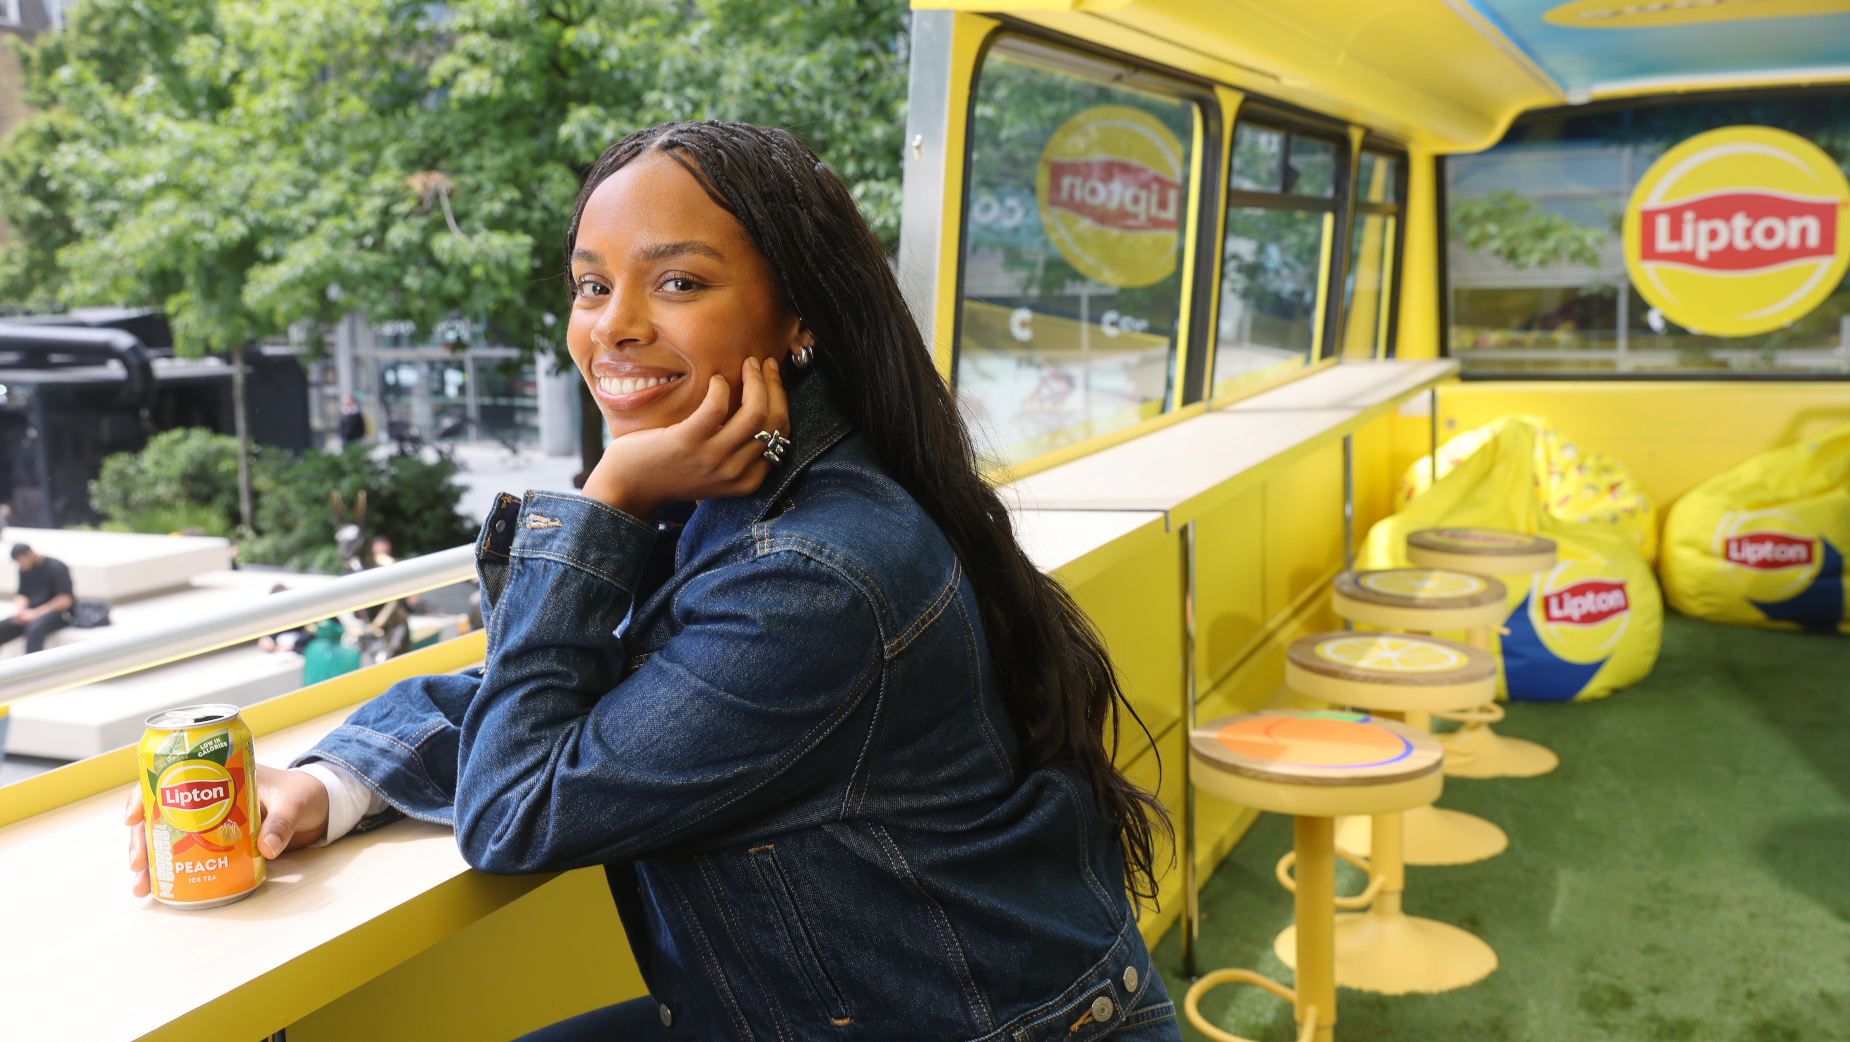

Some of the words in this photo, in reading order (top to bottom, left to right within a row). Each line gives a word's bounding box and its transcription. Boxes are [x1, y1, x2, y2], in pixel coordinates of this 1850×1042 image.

[1654, 210, 1821, 262] Lipton
[1728, 538, 1808, 565] Lipton
[1550, 588, 1626, 621] Lipton
[198, 741, 228, 757] CALORIES
[200, 740, 213, 750] LOW
[165, 786, 224, 806] Lipton
[175, 856, 229, 874] PEACH
